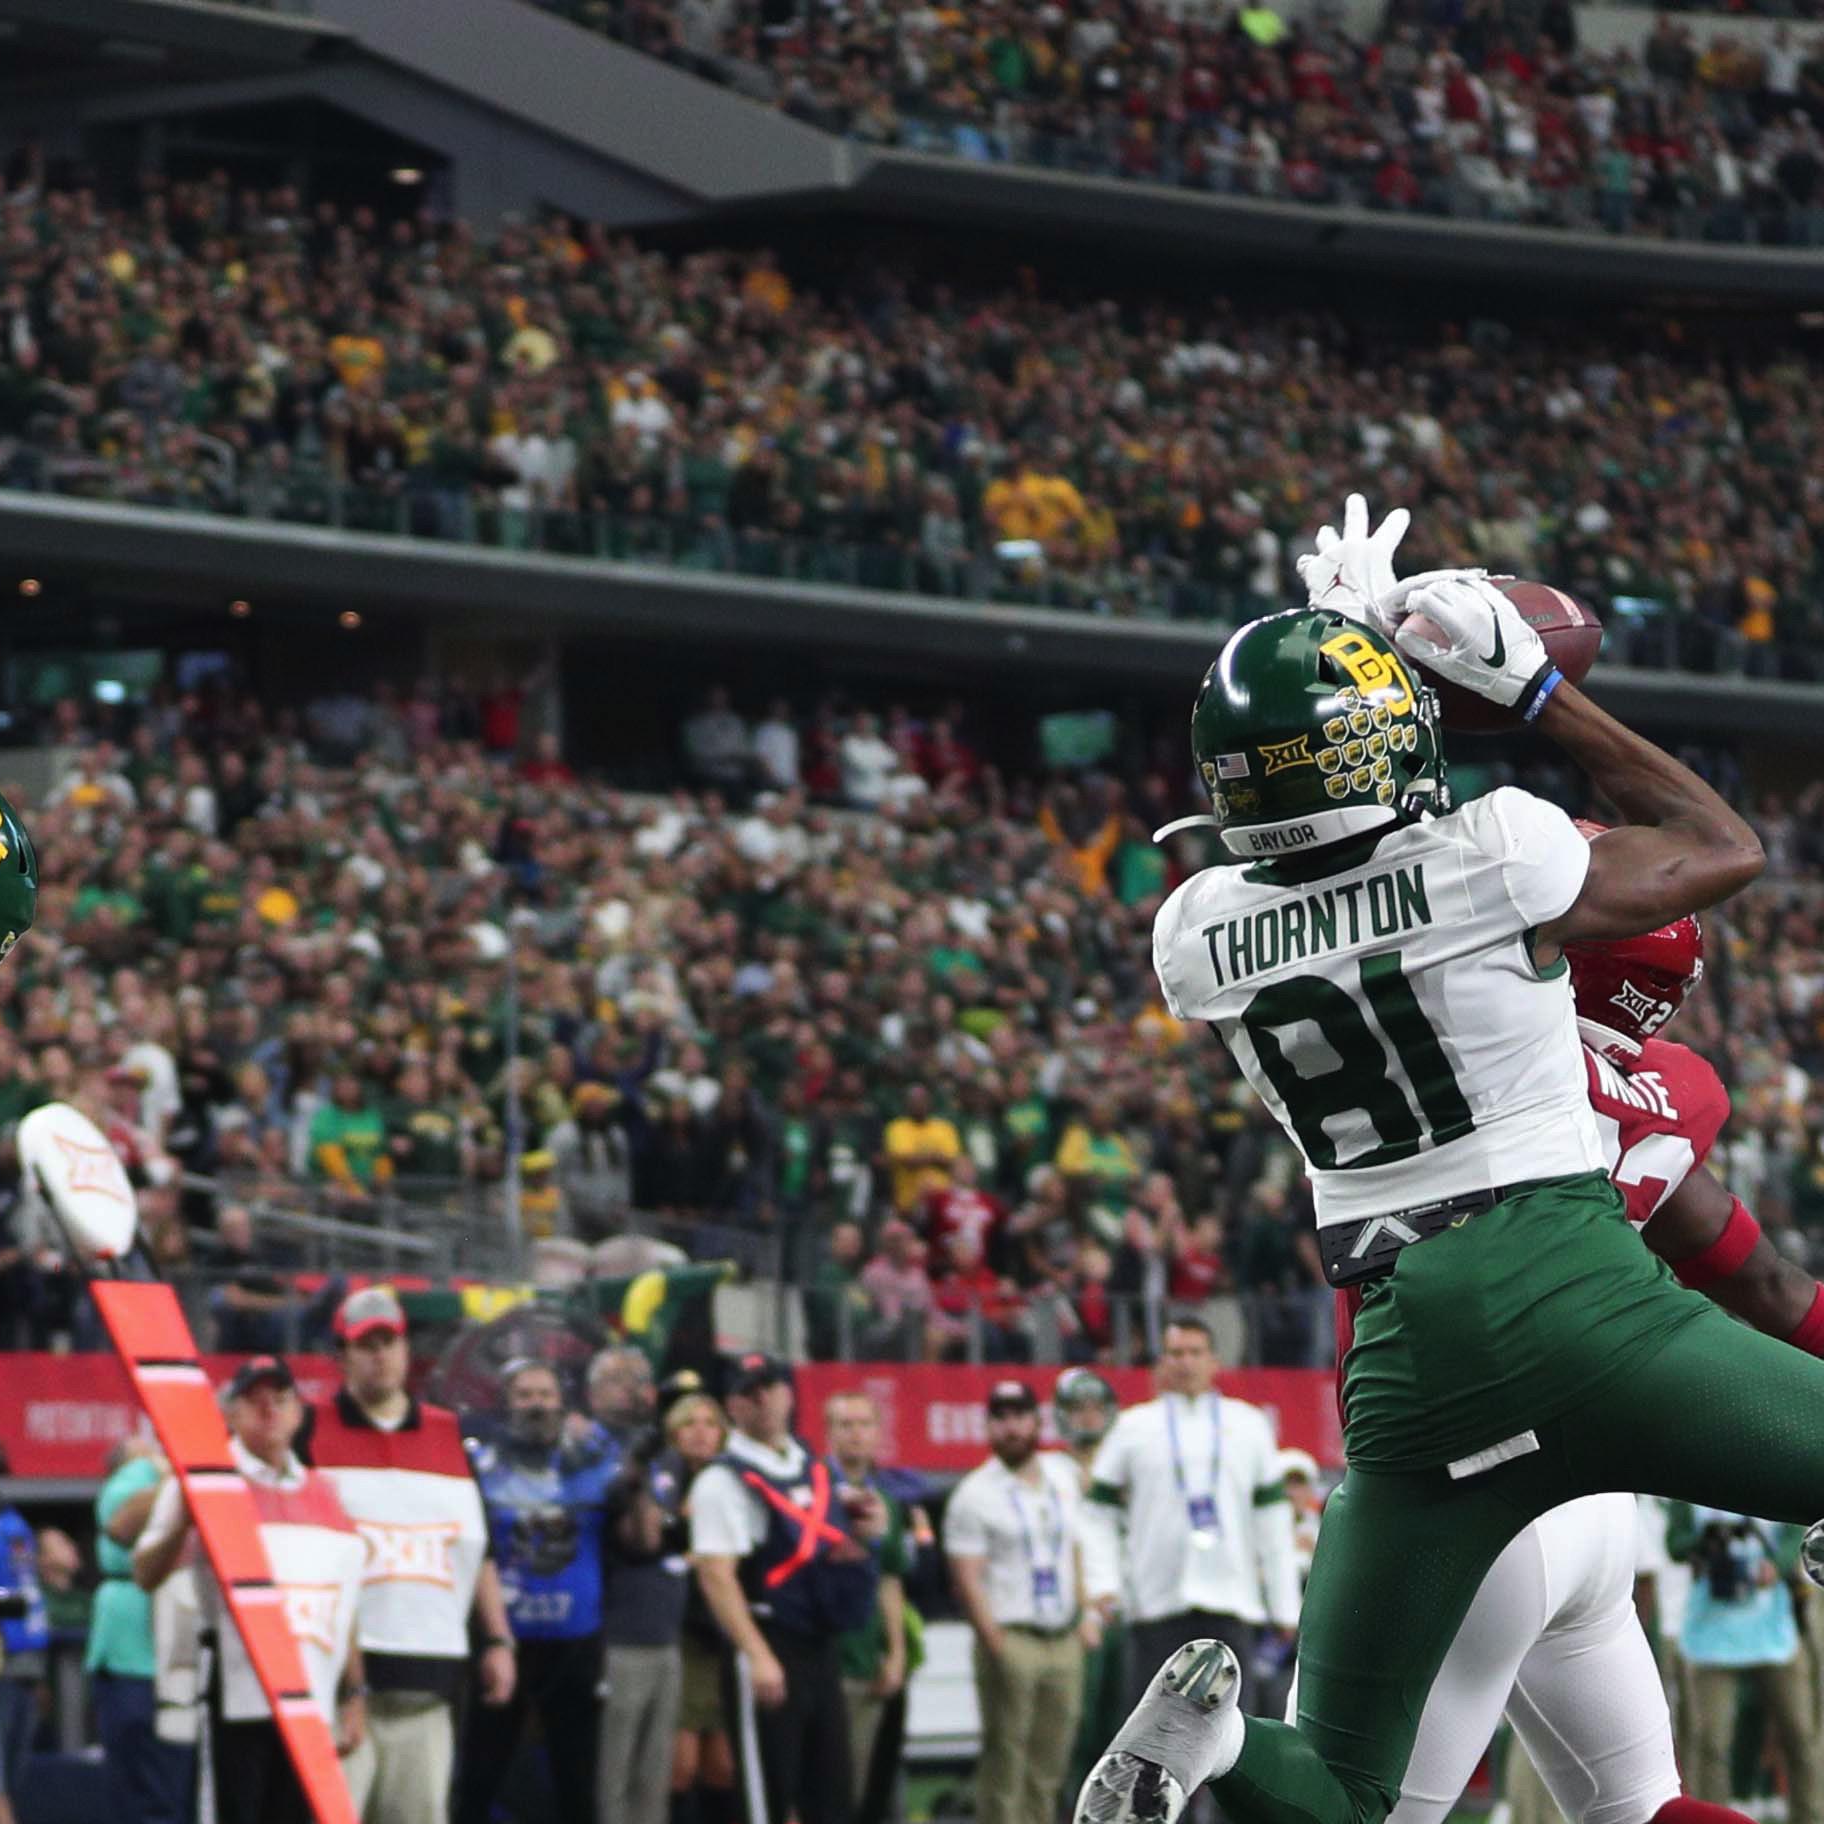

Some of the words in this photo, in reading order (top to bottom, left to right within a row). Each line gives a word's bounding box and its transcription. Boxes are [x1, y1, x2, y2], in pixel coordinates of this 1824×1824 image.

[1249, 823, 1318, 851] BAYLOR
[1202, 863, 1433, 987] THORNTON
[1241, 950, 1477, 1171] 81
